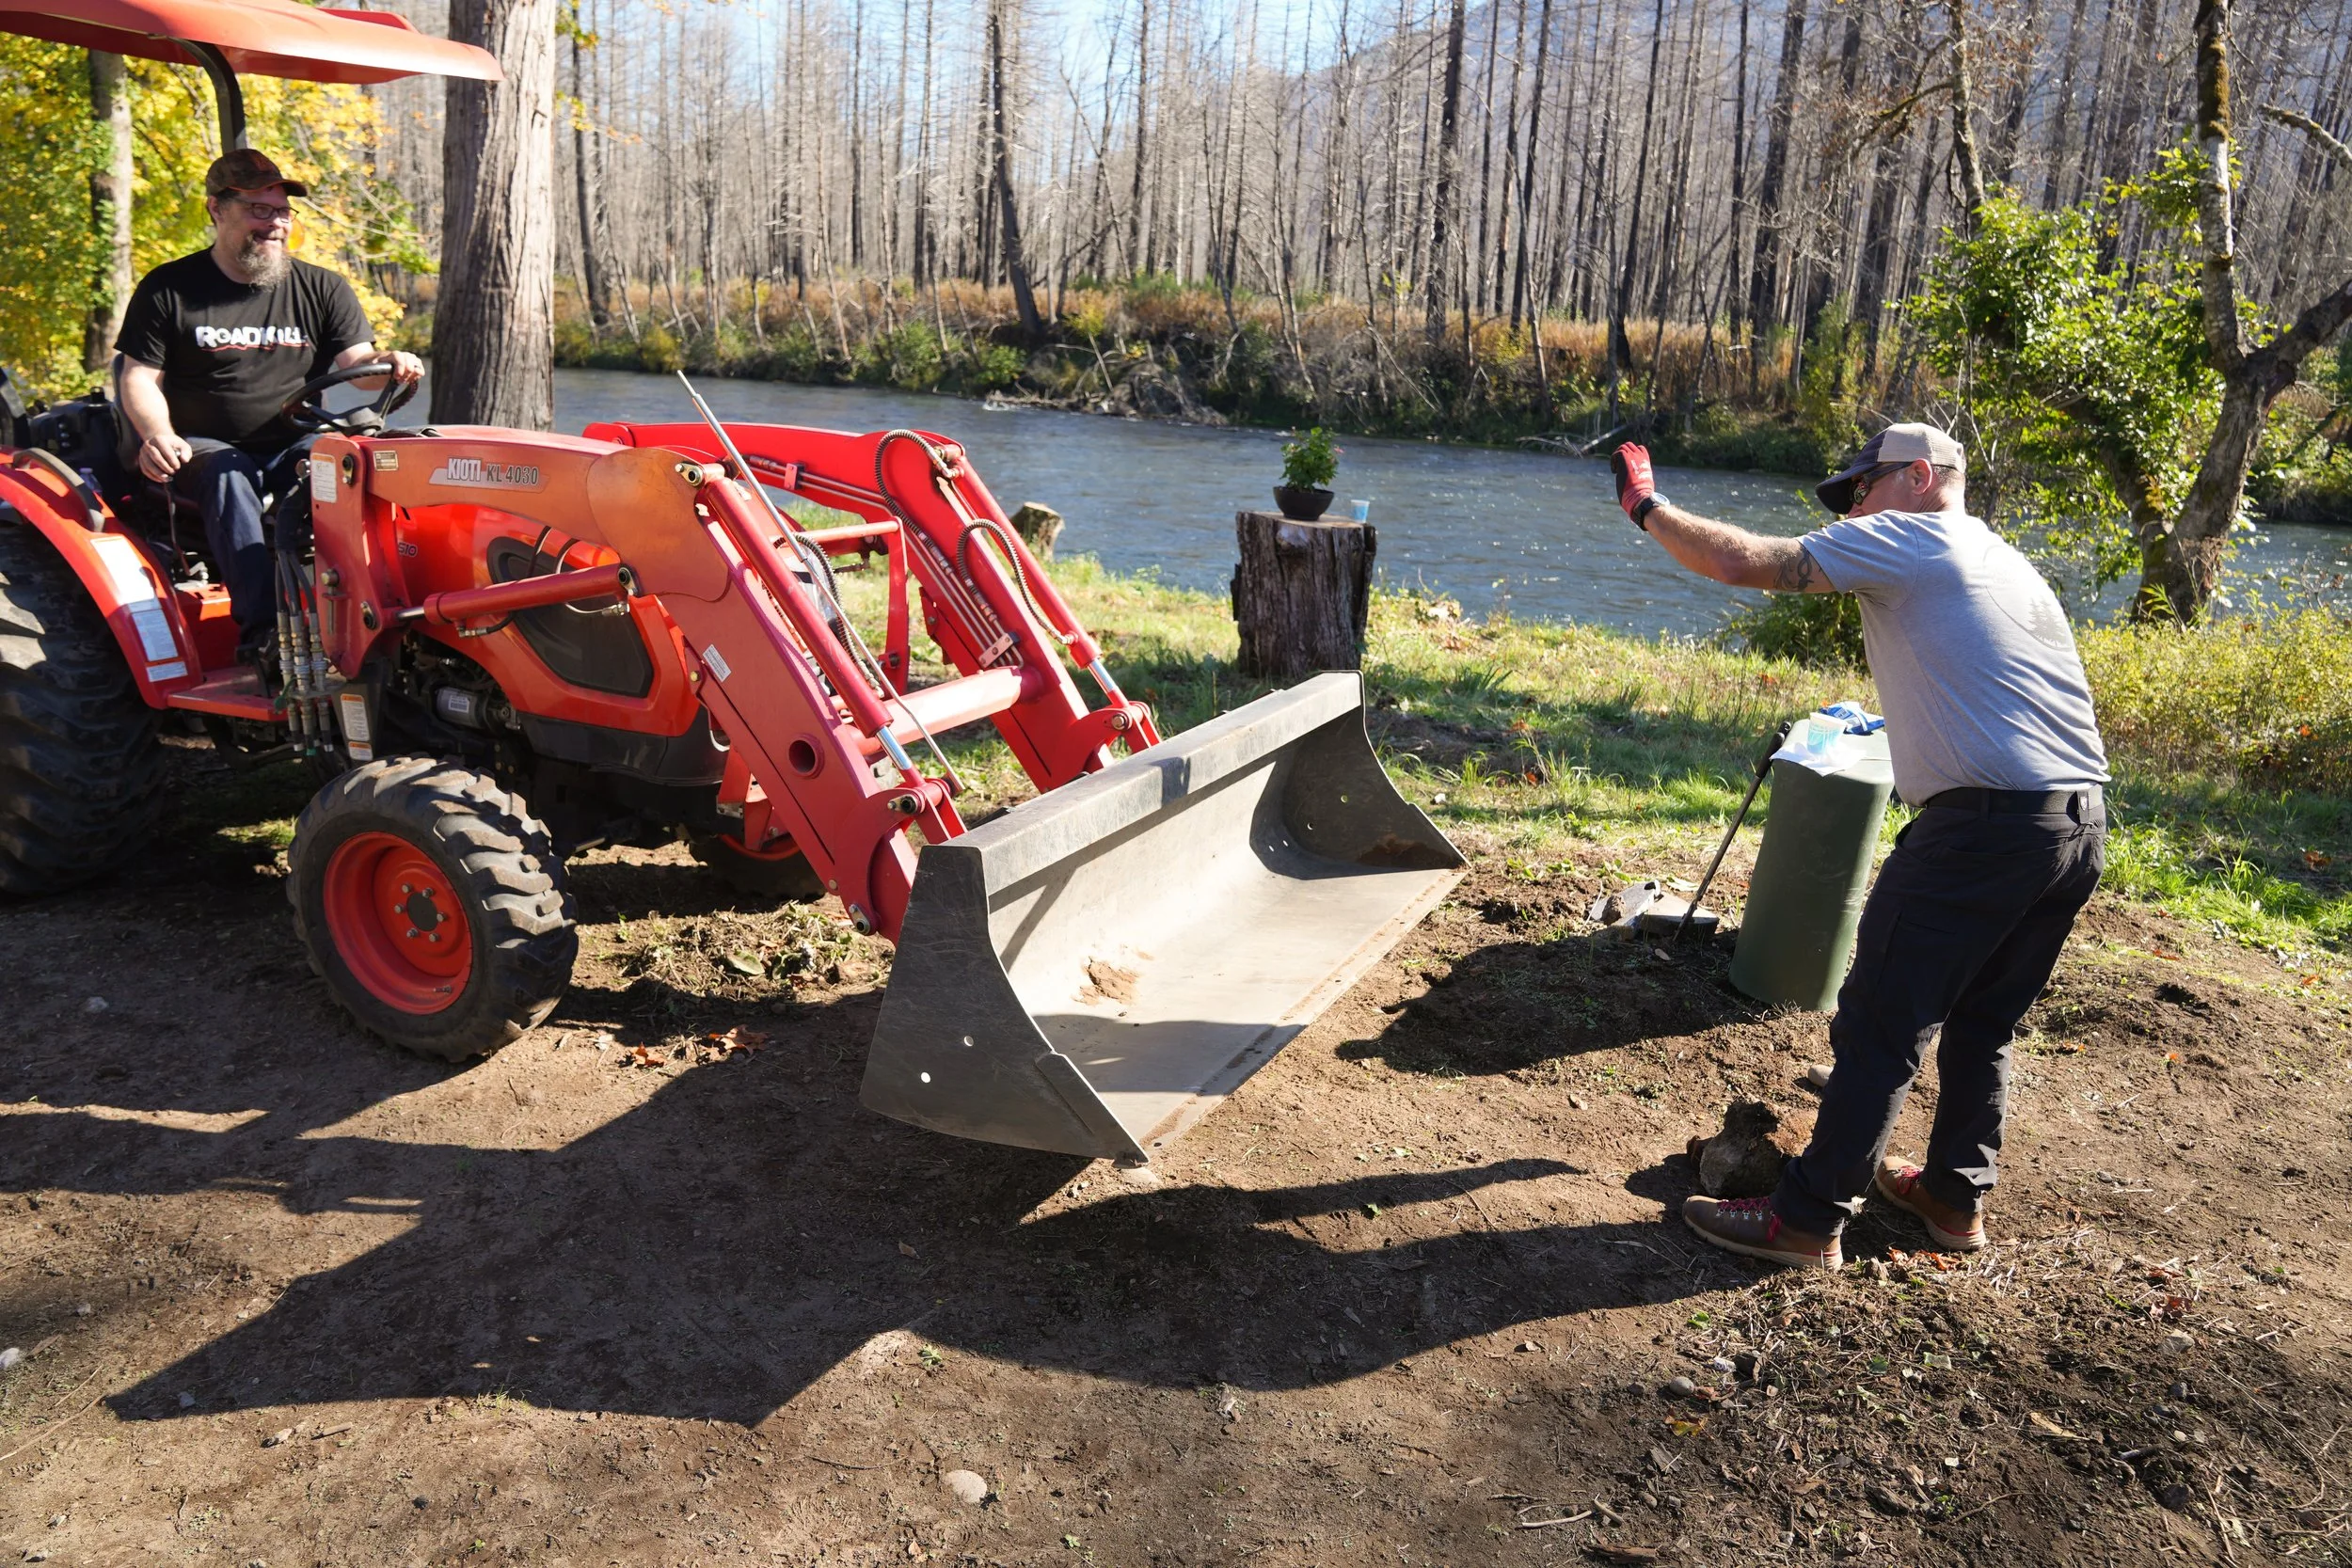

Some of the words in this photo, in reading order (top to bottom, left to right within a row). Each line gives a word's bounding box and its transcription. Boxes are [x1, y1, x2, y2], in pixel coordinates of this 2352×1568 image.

[447, 457, 482, 483] KIOTI
[485, 463, 502, 483] KL
[505, 465, 539, 486] 4030
